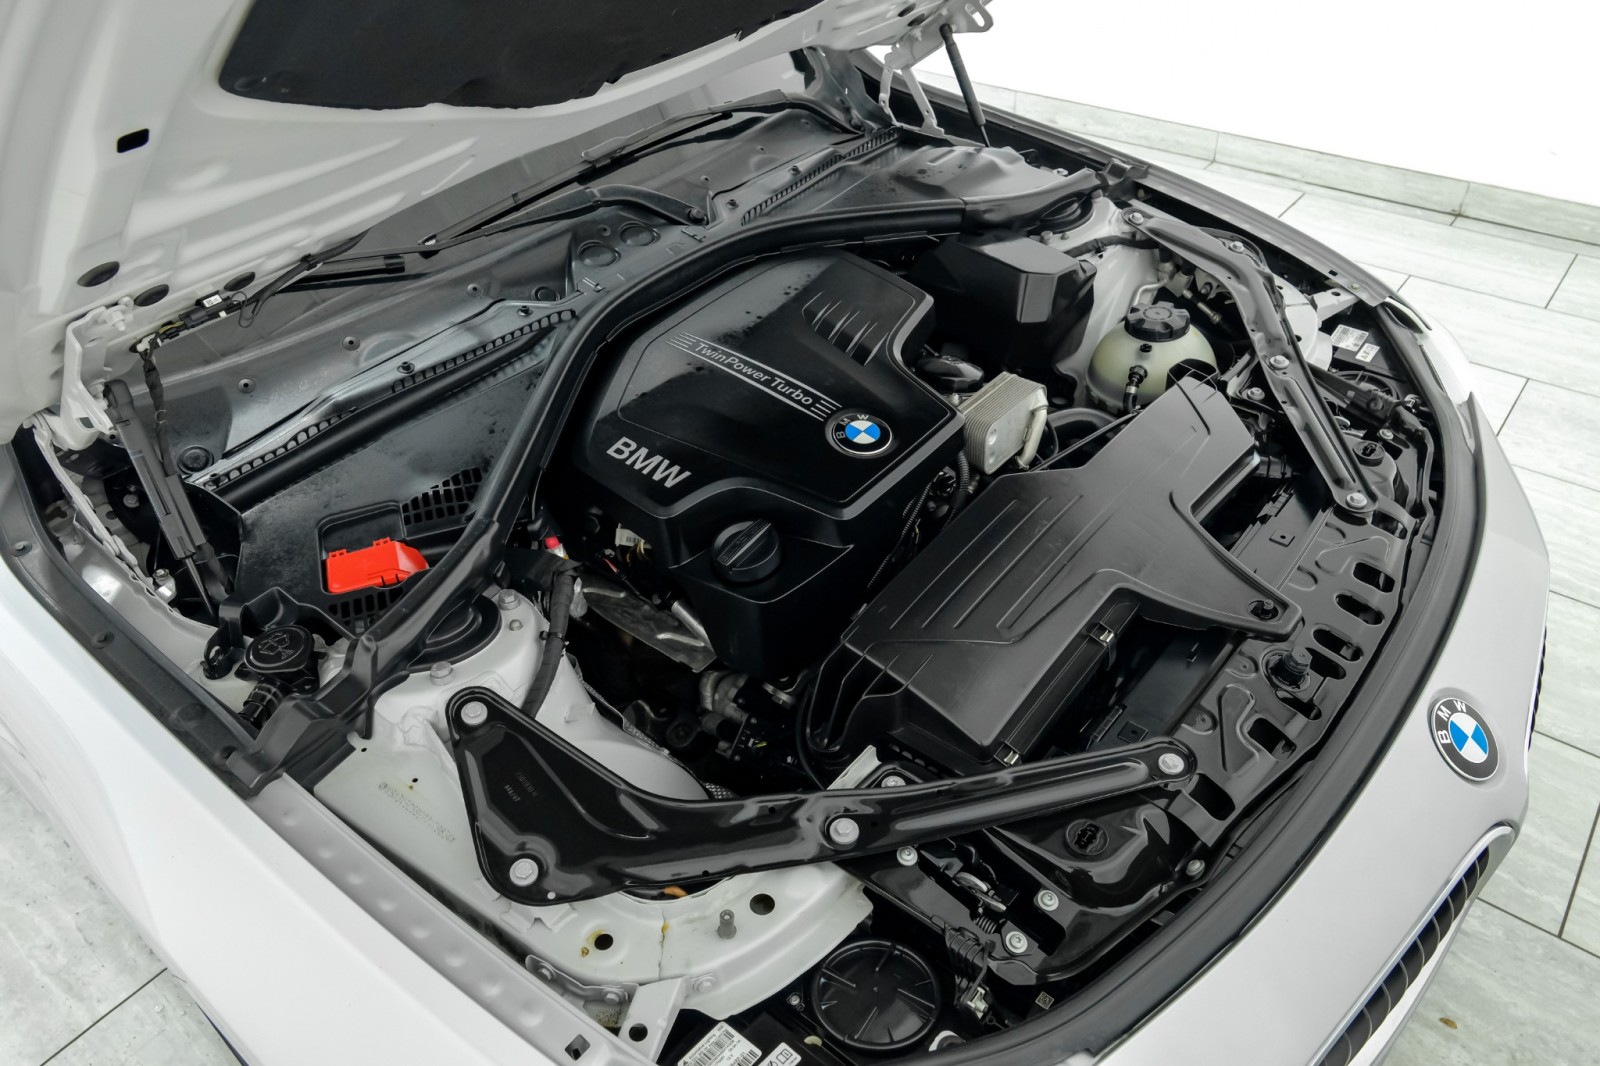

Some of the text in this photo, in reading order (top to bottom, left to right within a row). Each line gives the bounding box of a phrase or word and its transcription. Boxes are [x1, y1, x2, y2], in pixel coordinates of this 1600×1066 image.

[695, 342, 813, 405] TwinPower Turbo
[836, 414, 869, 439] BMW
[606, 436, 692, 488] BMW
[1437, 699, 1467, 744] BMW
